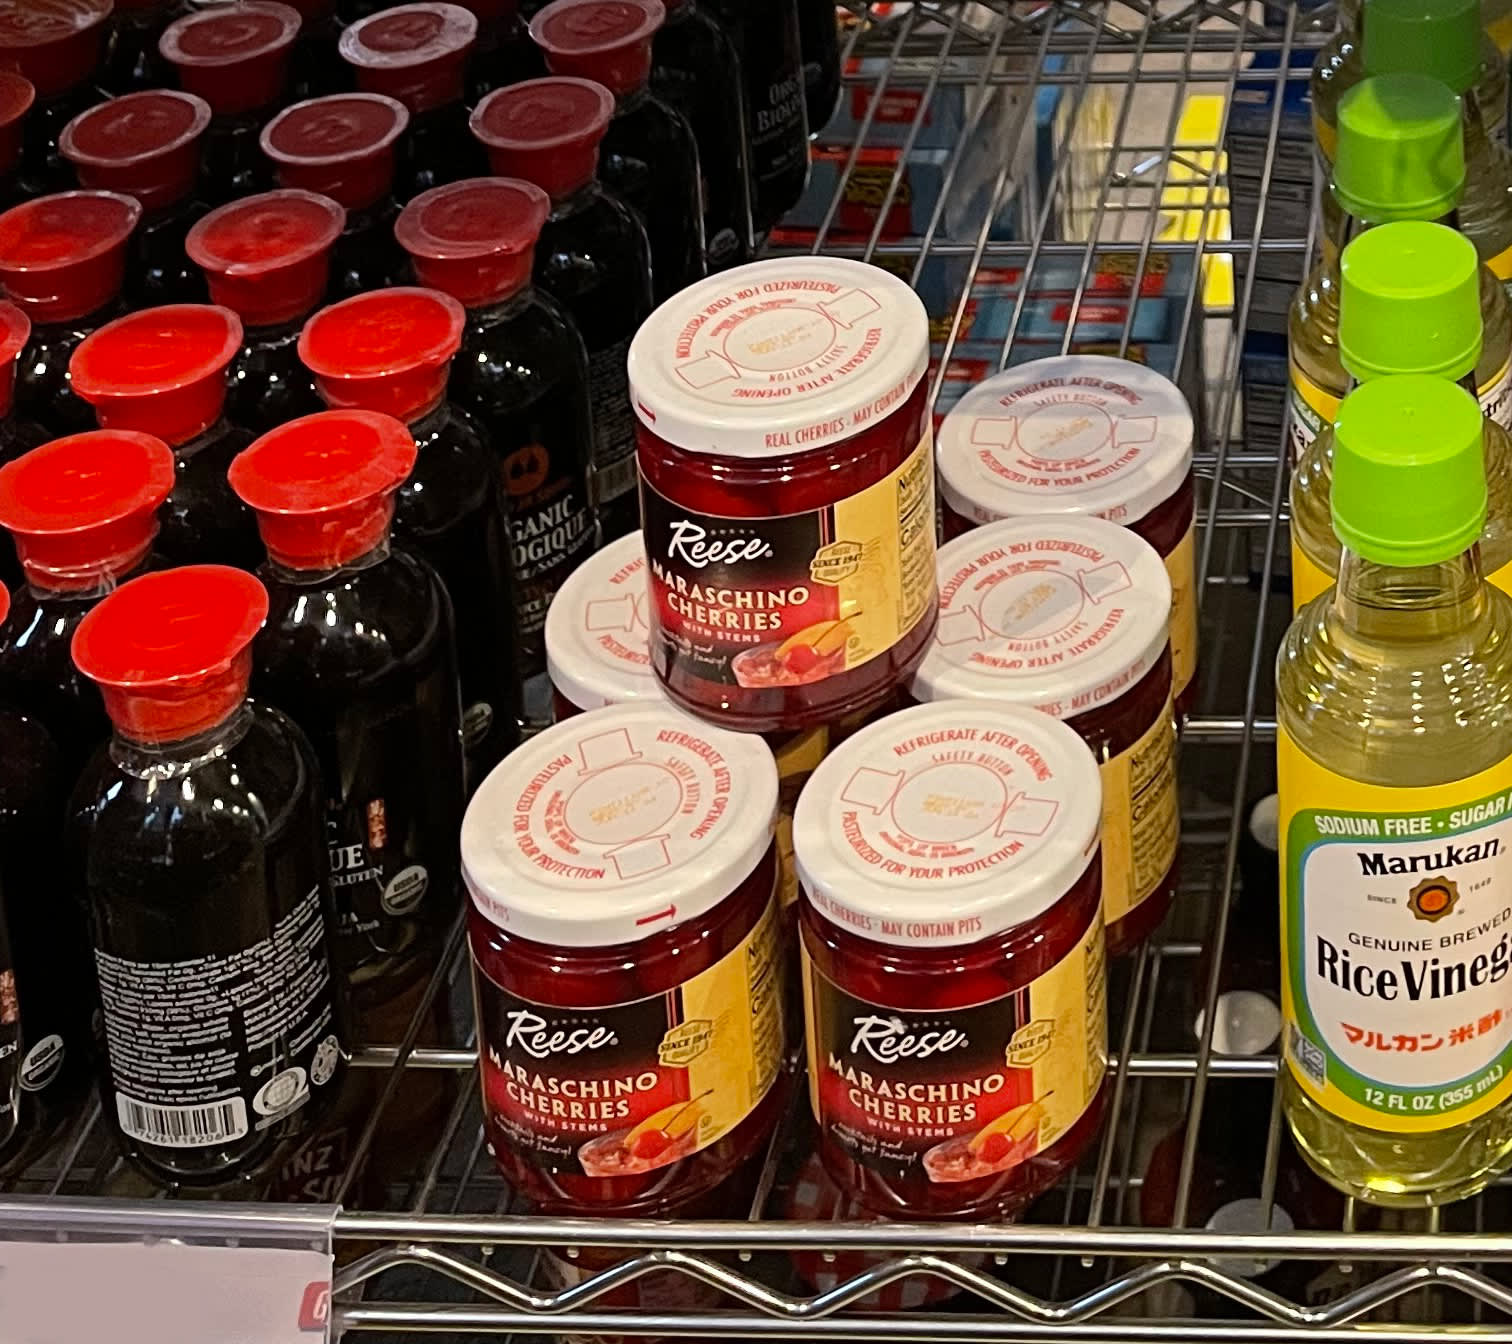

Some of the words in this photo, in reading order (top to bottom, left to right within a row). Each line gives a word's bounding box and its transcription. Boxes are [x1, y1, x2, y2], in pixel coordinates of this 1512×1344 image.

[765, 431, 793, 449] REAL
[796, 418, 846, 445] CHERRIES
[852, 409, 873, 426] MAY
[668, 519, 773, 568] Reese
[652, 559, 810, 610] MARASCHINO
[667, 591, 783, 632] CHERRIES
[1314, 815, 1381, 837] SODIUM
[1384, 816, 1433, 837] FREE
[1449, 799, 1507, 830] SUGAR
[841, 810, 883, 868] PASTEURIZED
[882, 856, 906, 876] FOR
[909, 864, 943, 880] YOUR
[948, 839, 1024, 878] PROTECTION
[1357, 838, 1500, 877] Marukan
[880, 918, 903, 937] MAY
[906, 919, 955, 938] CONTAIN
[957, 916, 982, 935] PITS
[1348, 931, 1433, 953] GENUINE
[1439, 906, 1512, 949] BREWED
[1316, 934, 1399, 1001] Rice
[505, 1010, 620, 1059] Reese
[850, 1016, 967, 1064] Reese
[1339, 1021, 1446, 1053] マルカン
[488, 1044, 658, 1099] MARASCHINO
[827, 1050, 1005, 1102] MARASCHINO
[1364, 1086, 1385, 1104] 12
[1387, 1093, 1409, 1111] FL
[1412, 1093, 1436, 1112] OZ
[1438, 1085, 1475, 1112] (355
[1475, 1064, 1504, 1095] mL)
[505, 1079, 630, 1120] CHERRIES
[848, 1085, 977, 1124] CHERRIES
